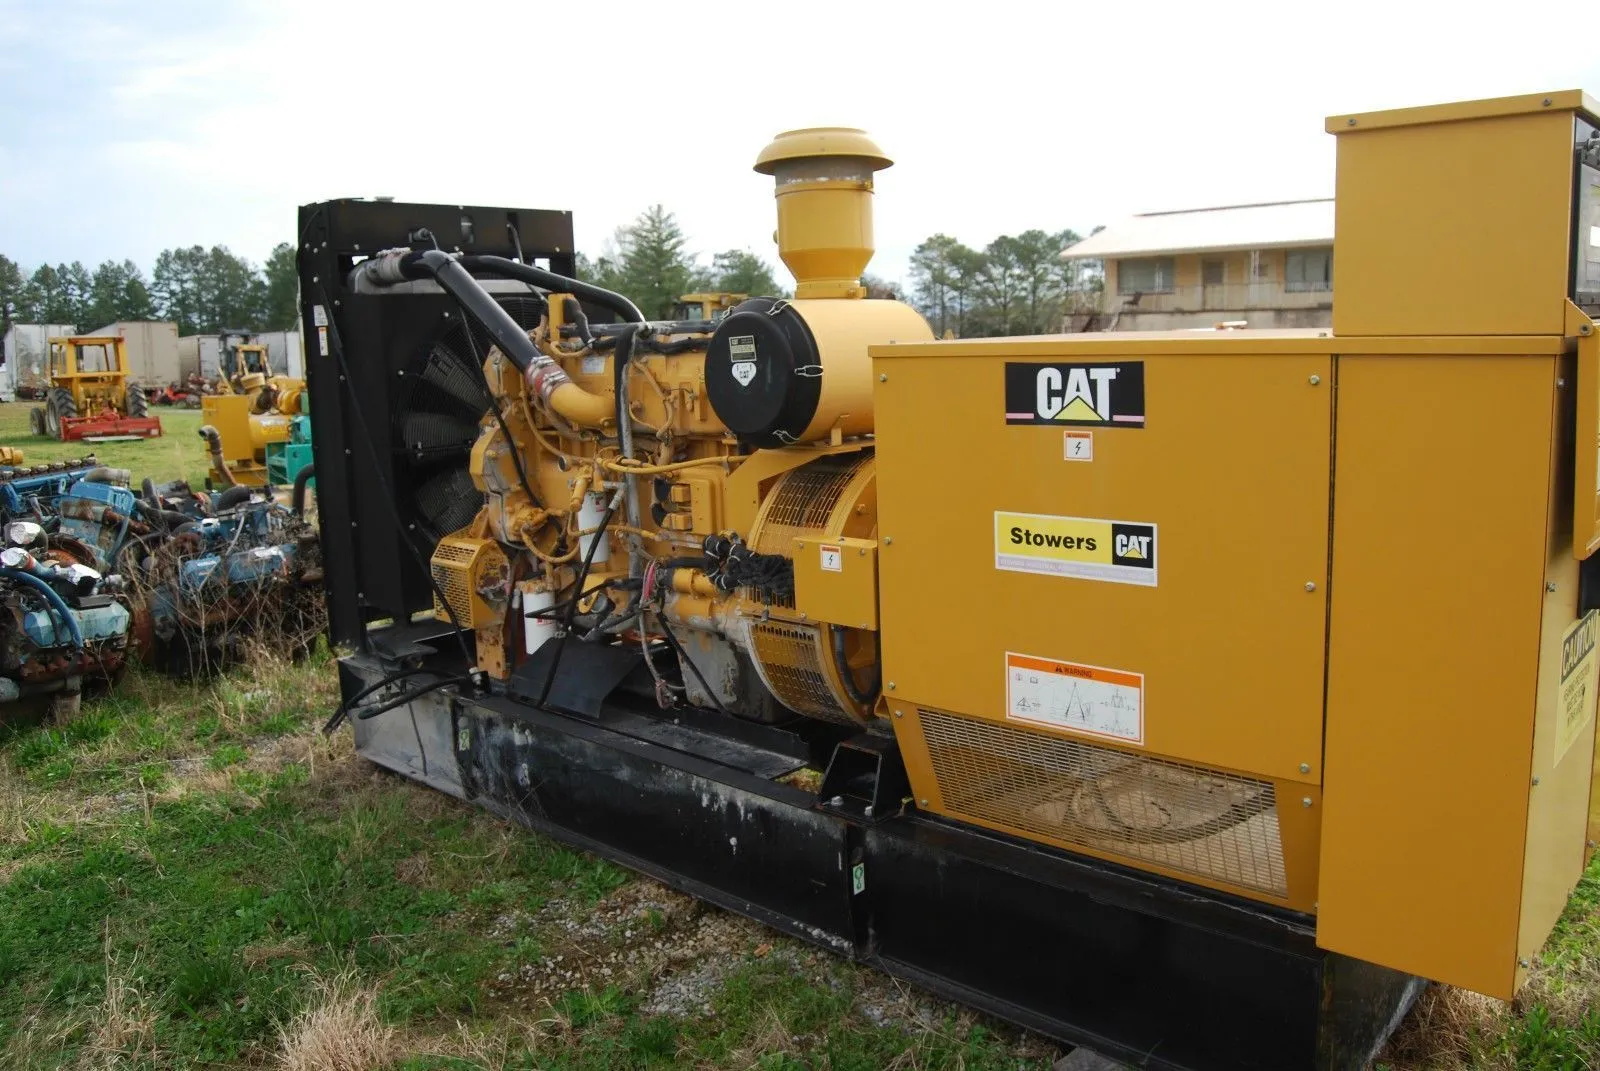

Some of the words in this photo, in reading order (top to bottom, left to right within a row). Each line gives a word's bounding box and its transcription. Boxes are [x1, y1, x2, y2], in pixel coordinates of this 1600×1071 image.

[1036, 367, 1117, 421] CAT
[1010, 527, 1097, 551] Stowers
[1115, 533, 1151, 560] CAT
[1064, 667, 1092, 678] WARNING
